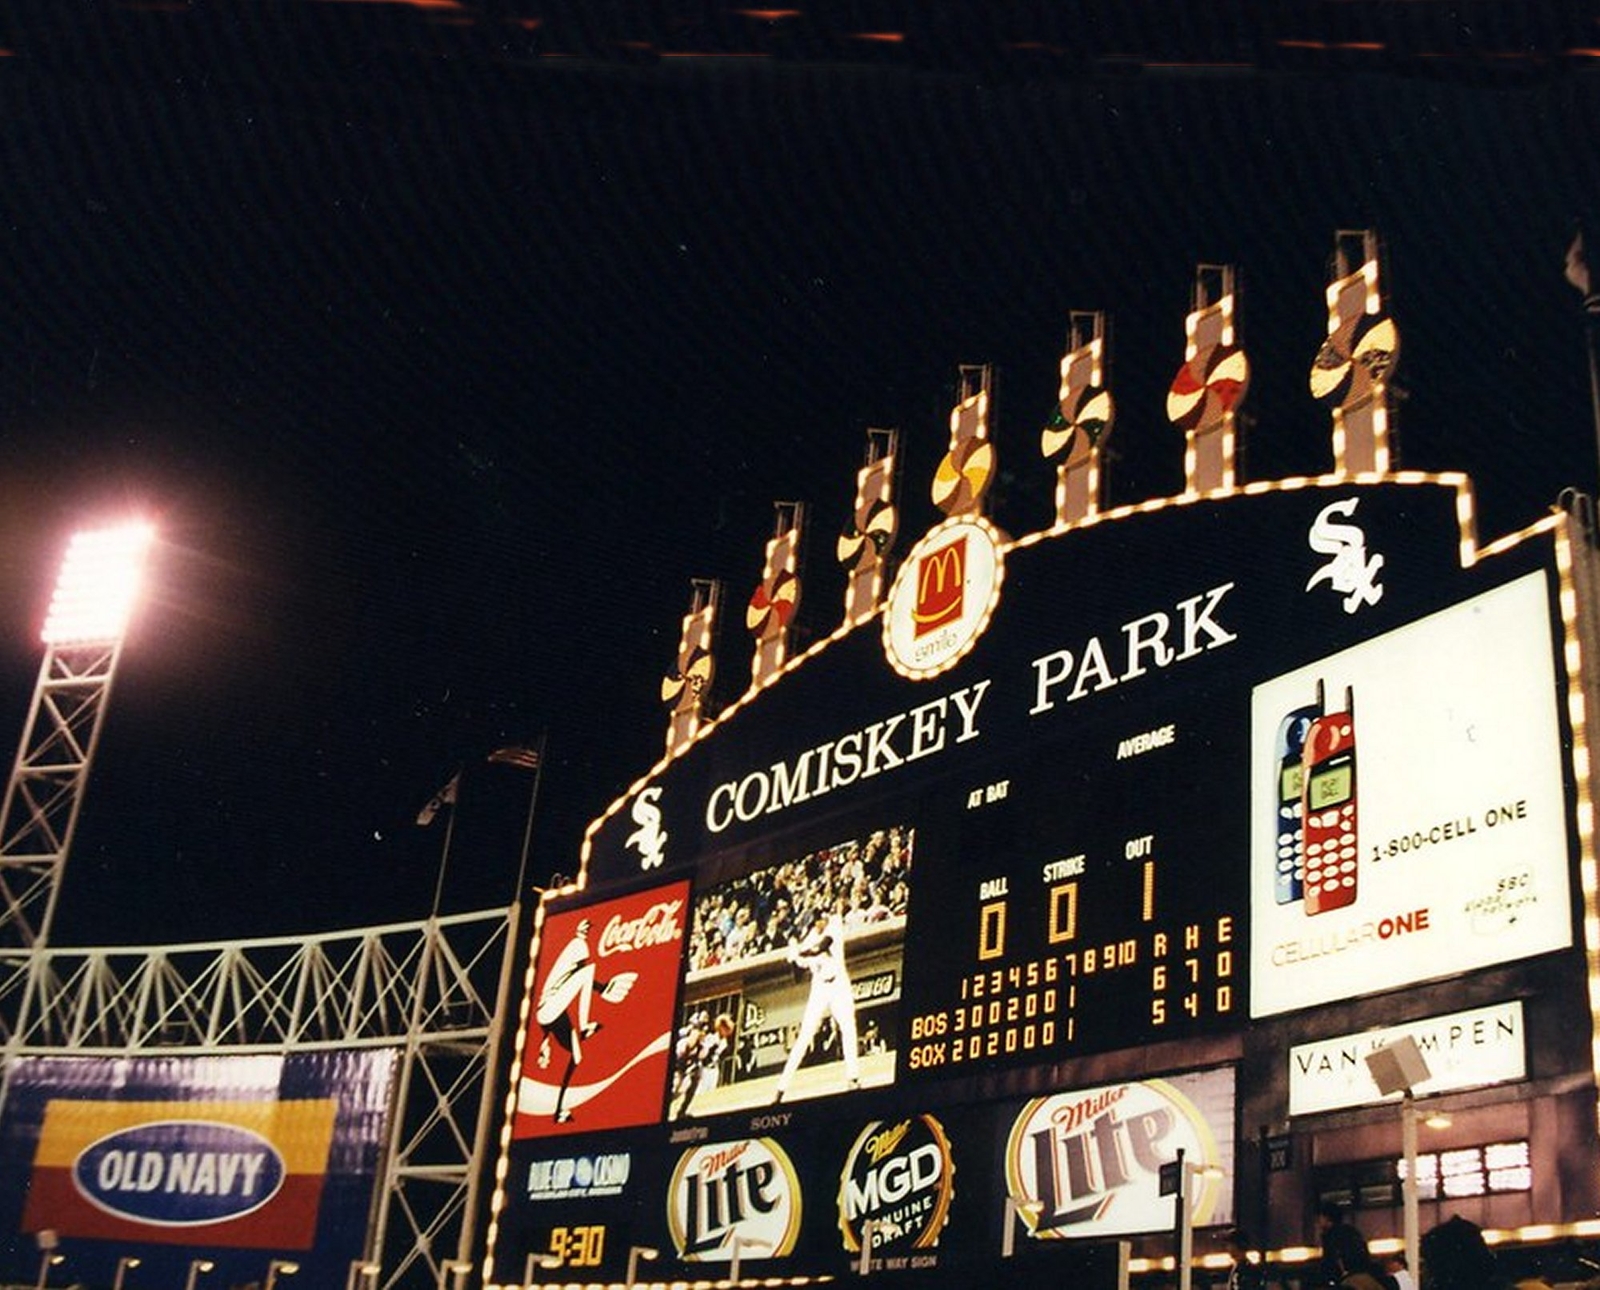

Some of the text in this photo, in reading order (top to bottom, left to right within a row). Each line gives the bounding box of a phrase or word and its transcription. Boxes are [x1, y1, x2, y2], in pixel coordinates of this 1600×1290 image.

[706, 582, 1238, 833] COMISKEY PARK
[1116, 724, 1176, 761] AVERAGE
[966, 779, 1010, 810] AT BAT
[1484, 799, 1528, 829] ONE
[1125, 835, 1154, 861] OUT
[1042, 854, 1086, 883] STRIKE
[979, 876, 1009, 901] BALL
[911, 1012, 948, 1040] BOS
[909, 1042, 946, 1070] SOX
[1297, 1048, 1357, 1074] VAN
[751, 1114, 792, 1130] SONY
[1052, 1087, 1129, 1132] Miller
[99, 1150, 267, 1196] OLD NAVY
[701, 1141, 751, 1177] Miller
[1032, 1106, 1176, 1232] Lite
[846, 1143, 942, 1221] MGD
[683, 1161, 782, 1255] Lite
[549, 1225, 606, 1268] 9:30
[911, 1255, 937, 1269] SIGN
